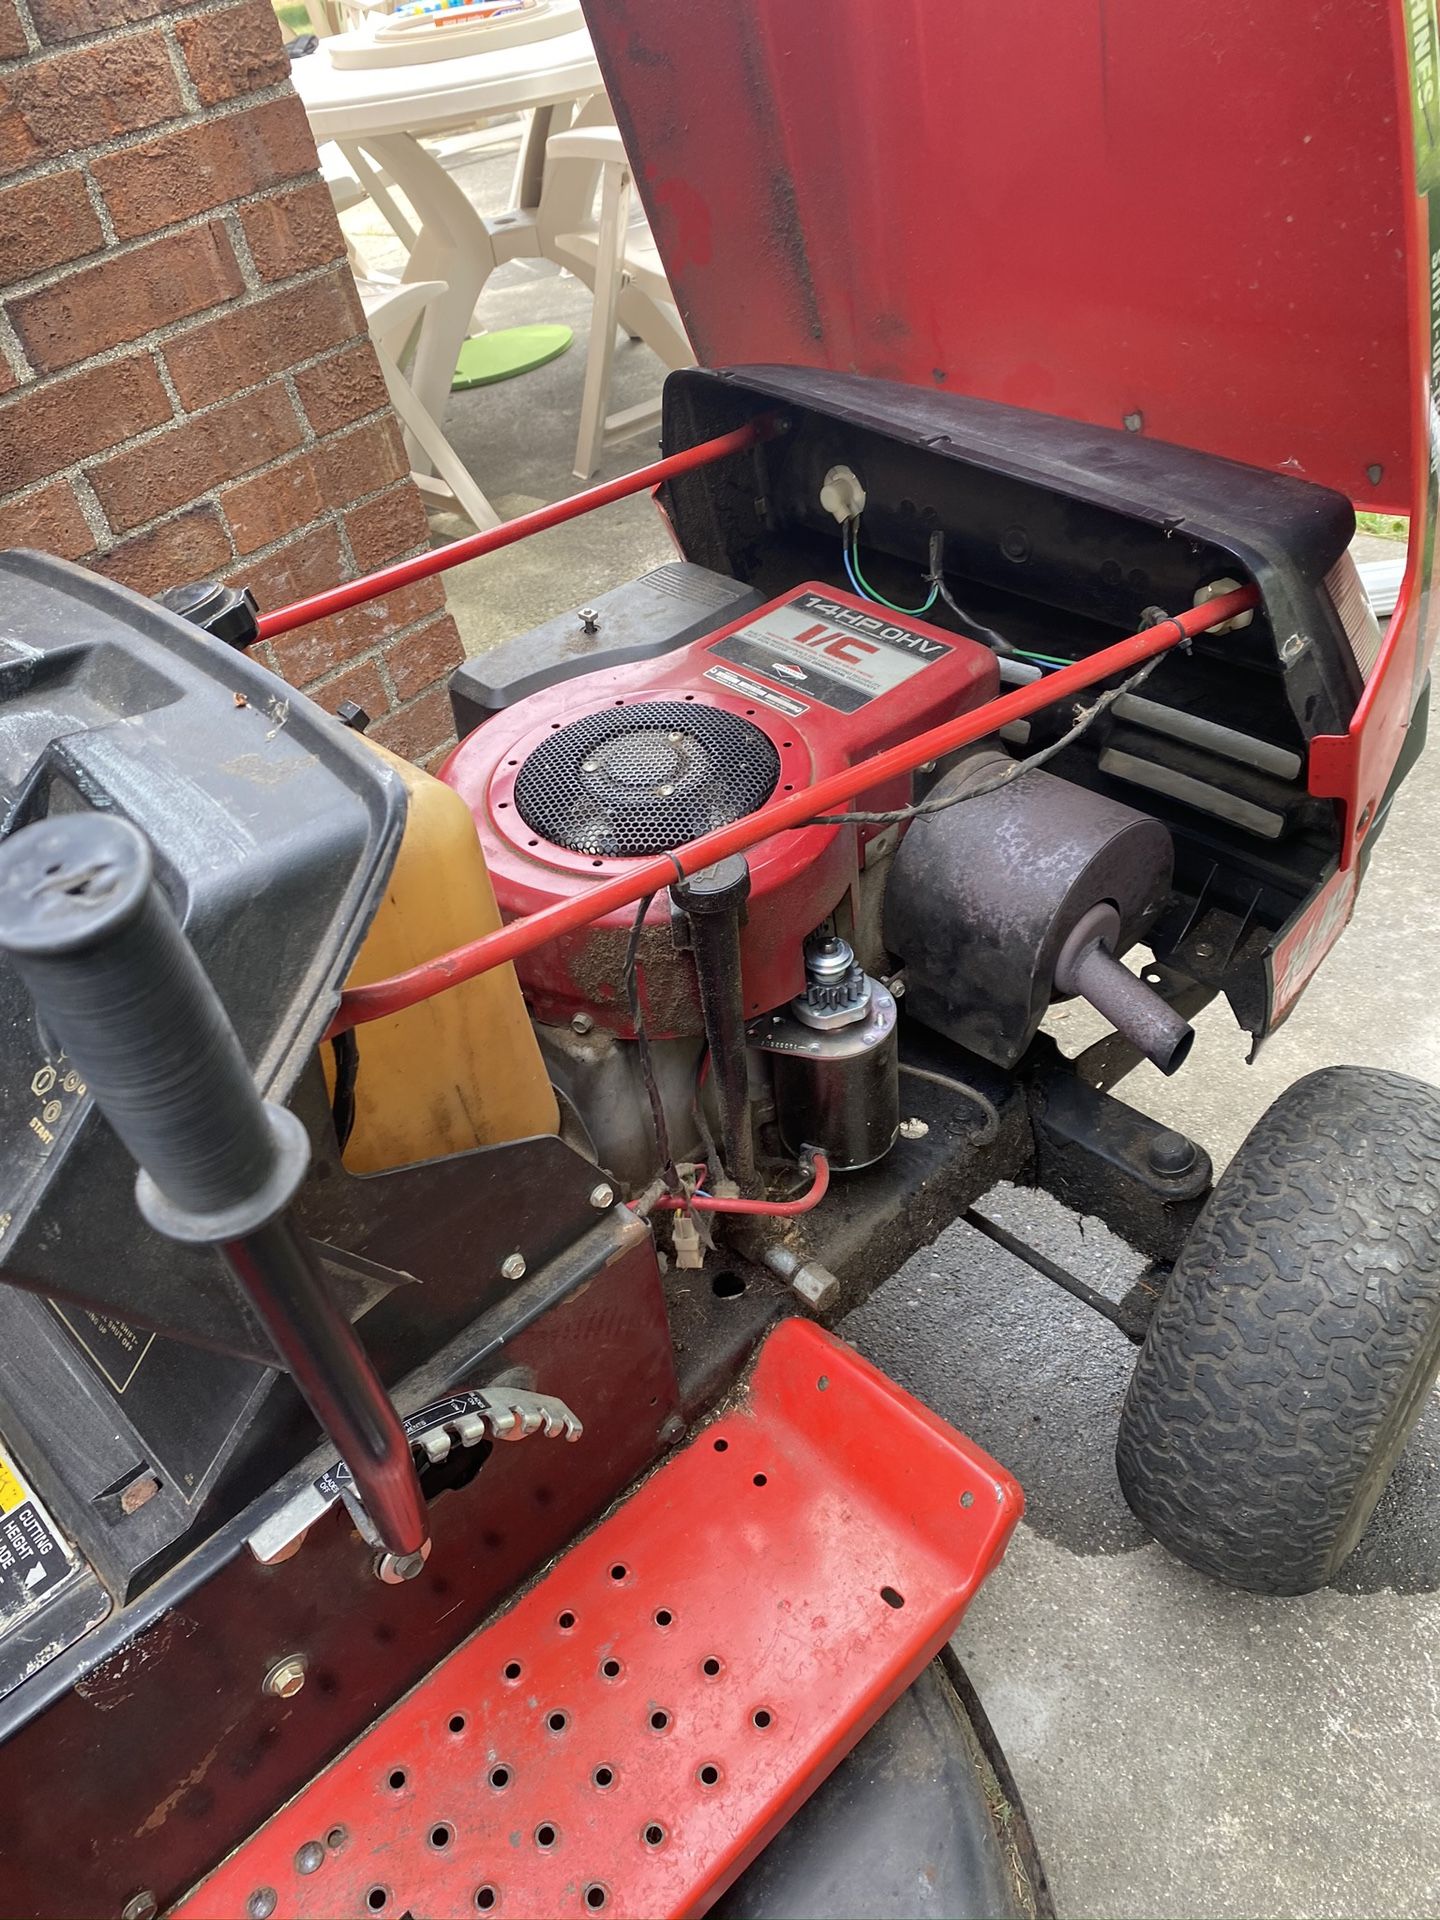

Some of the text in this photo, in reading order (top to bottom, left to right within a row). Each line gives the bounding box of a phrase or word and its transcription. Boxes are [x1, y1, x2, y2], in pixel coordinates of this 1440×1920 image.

[793, 623, 881, 665] I/C
[879, 625, 944, 654] OHV
[29, 1116, 54, 1145] START
[319, 1481, 331, 1493] OFF
[322, 1472, 340, 1494] BLADES
[2, 1519, 35, 1560] HEIGHT
[19, 1508, 53, 1555] CUTTING
